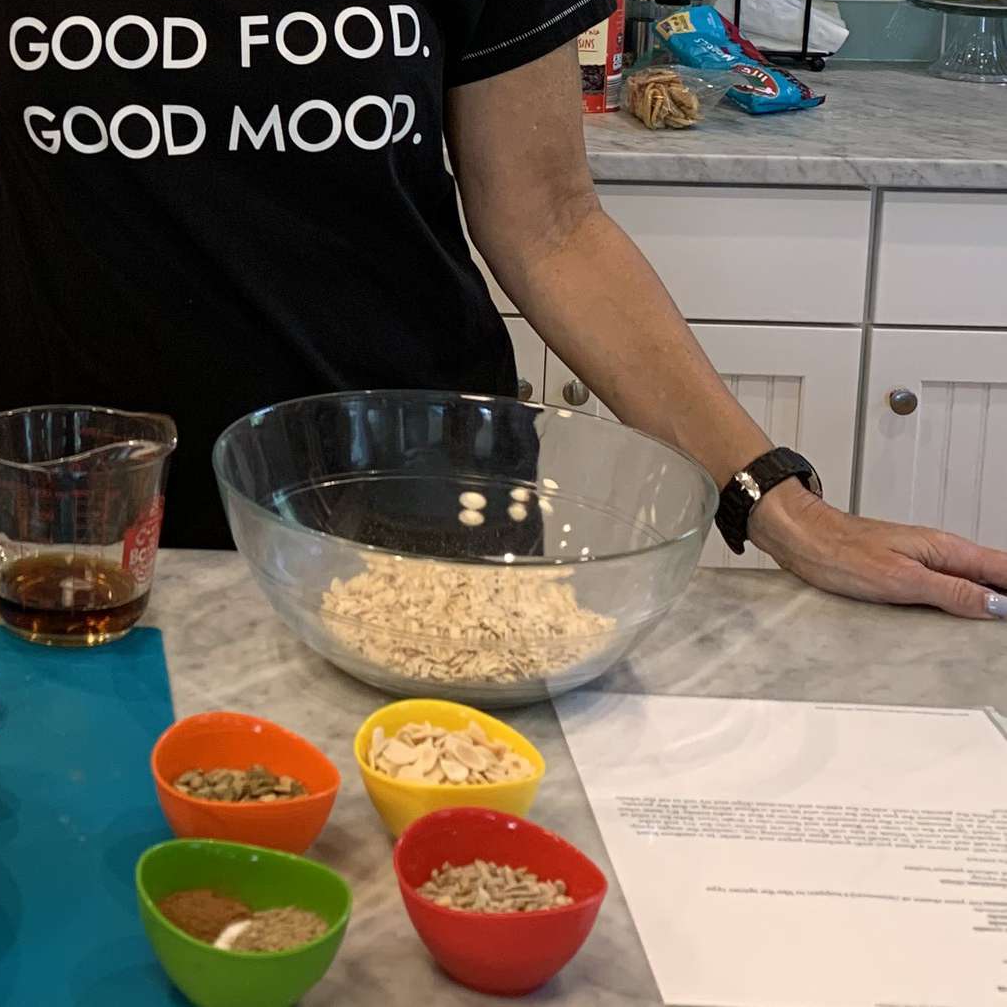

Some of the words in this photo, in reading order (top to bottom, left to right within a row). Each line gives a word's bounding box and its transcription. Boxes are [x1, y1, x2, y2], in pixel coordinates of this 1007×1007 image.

[9, 14, 207, 71] GOOD
[240, 5, 430, 67] FOOD.
[23, 104, 206, 159] GOOD
[229, 94, 422, 152] MOOD.
